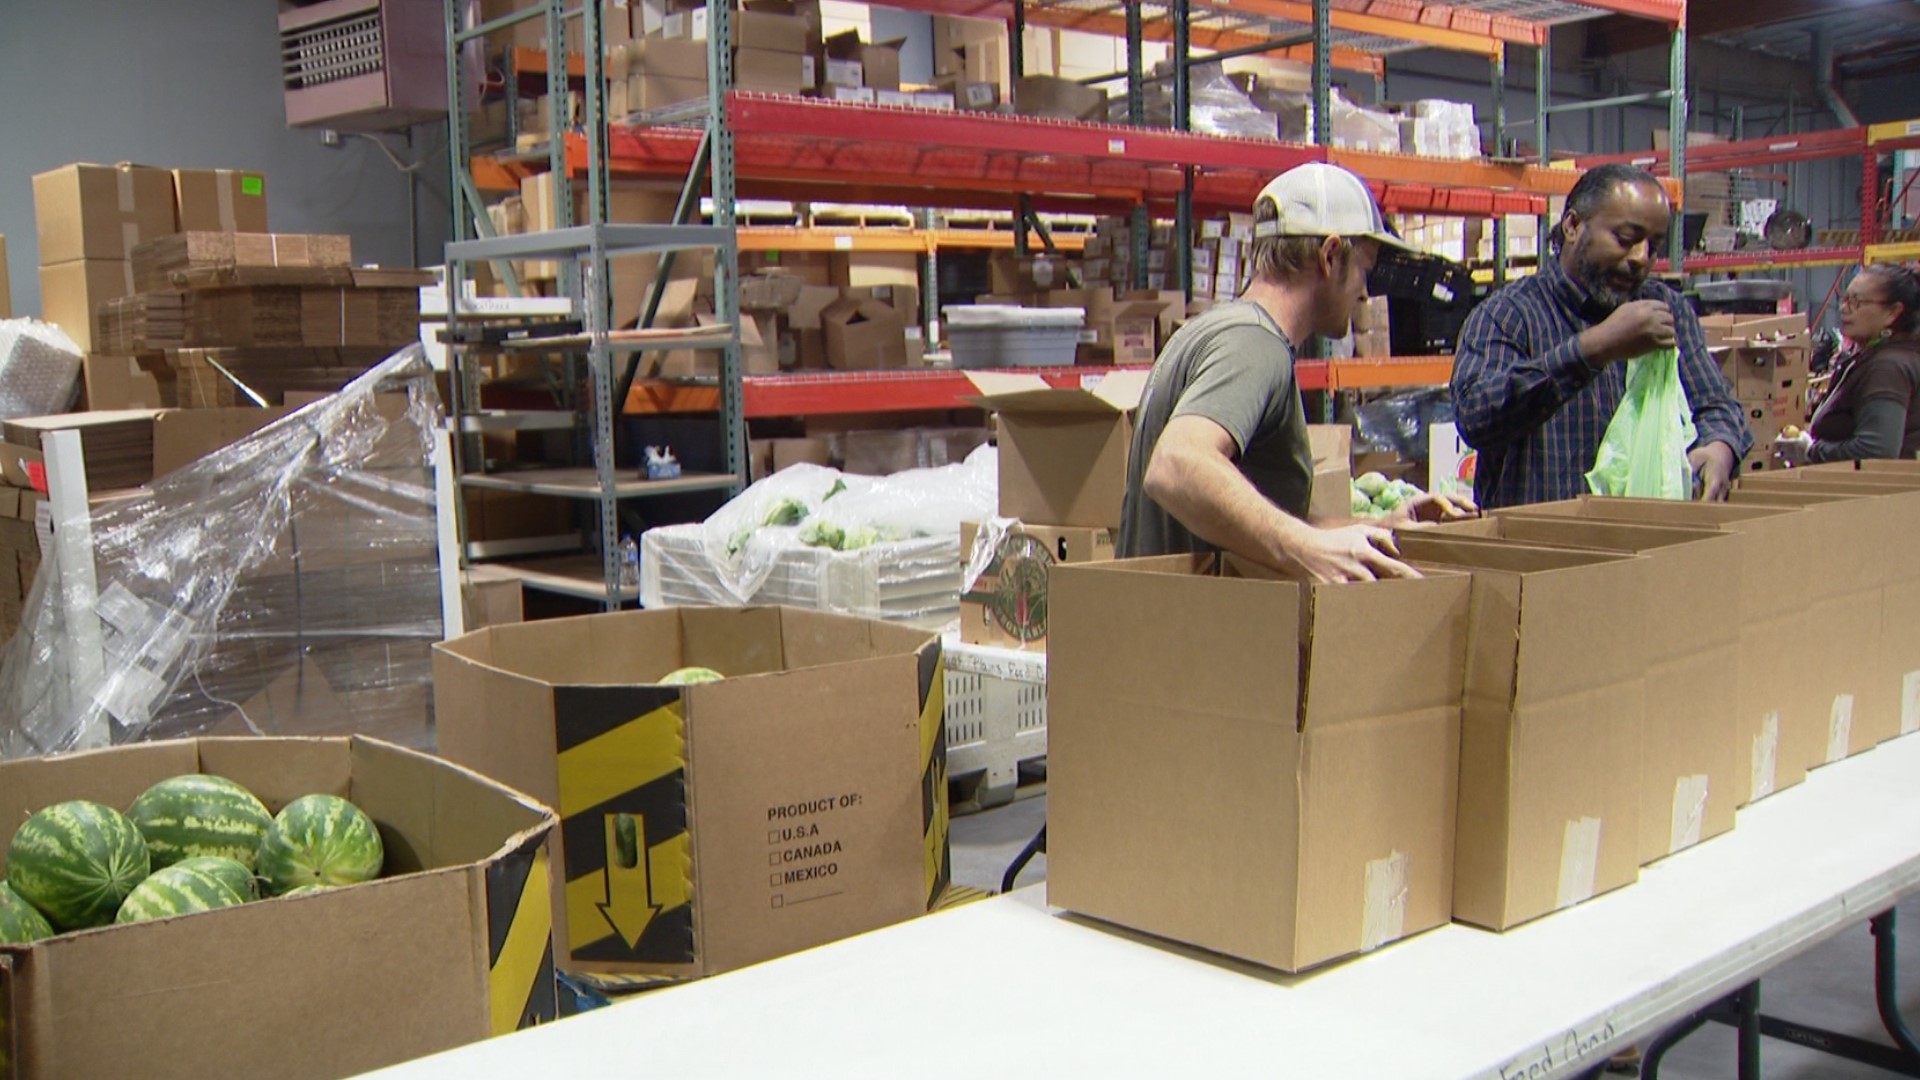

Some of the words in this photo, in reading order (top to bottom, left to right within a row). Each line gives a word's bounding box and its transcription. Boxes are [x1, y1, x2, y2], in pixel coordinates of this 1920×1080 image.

[767, 796, 835, 821] PRODUCT
[839, 793, 862, 808] OF:
[782, 823, 819, 841] U.S.A
[783, 840, 842, 863] CANADA
[784, 862, 838, 884] MEXICO
